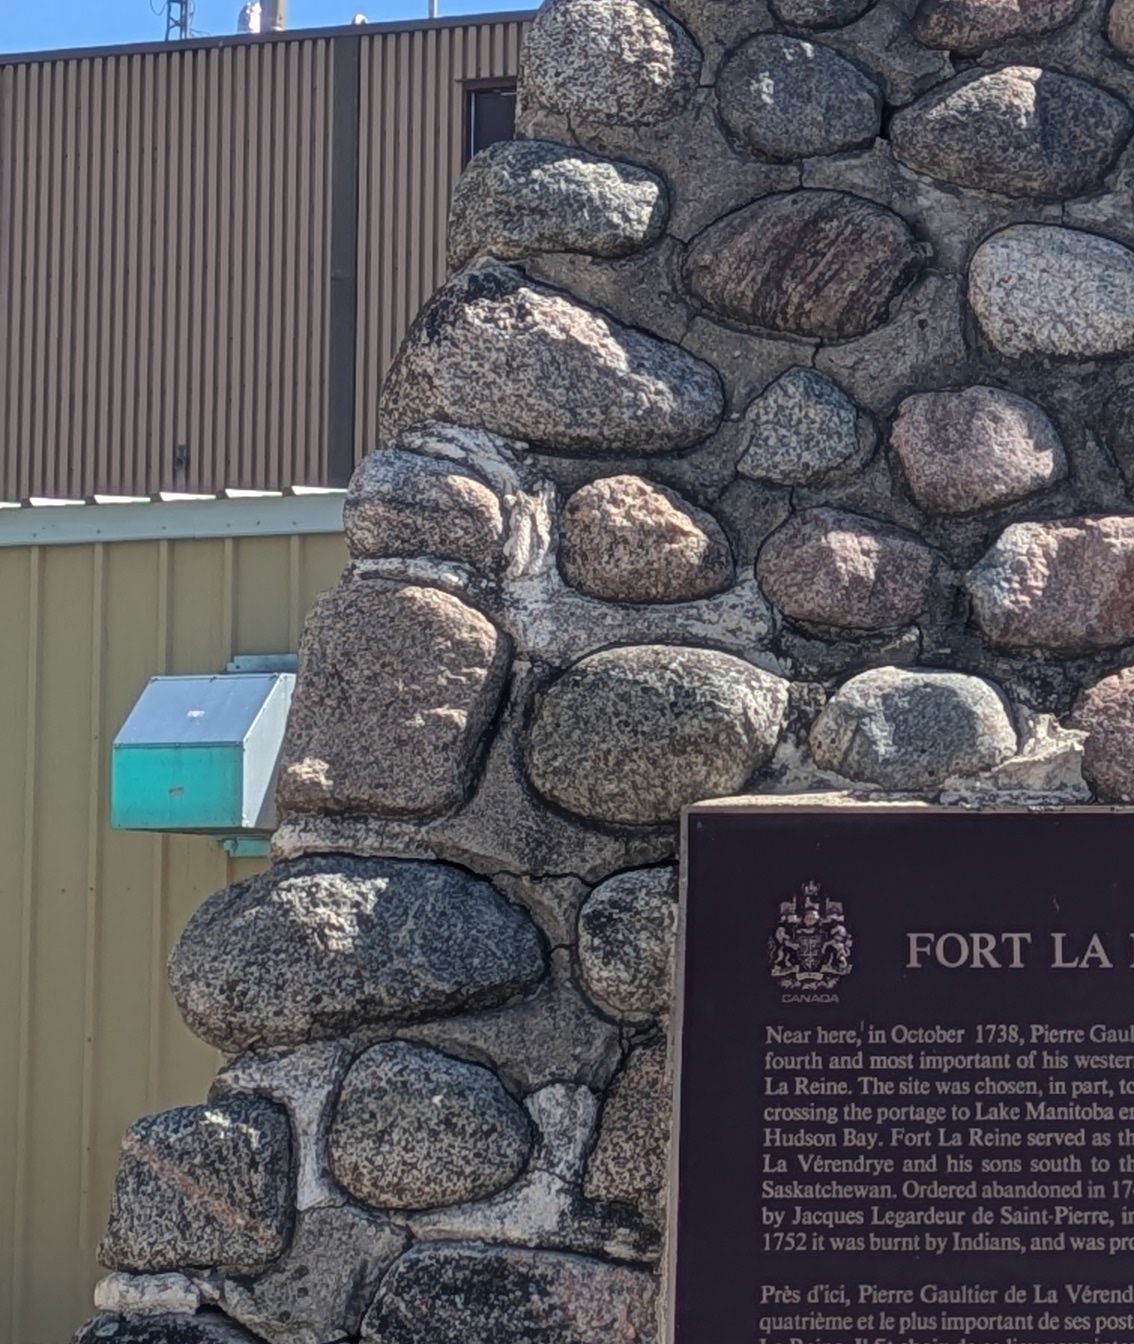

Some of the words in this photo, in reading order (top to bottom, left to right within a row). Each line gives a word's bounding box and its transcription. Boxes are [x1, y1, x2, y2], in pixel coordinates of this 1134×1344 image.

[905, 932, 1032, 969] FORT
[1050, 932, 1114, 969] LA
[781, 993, 840, 1004] CANADA
[764, 1025, 812, 1045] Near
[816, 1025, 864, 1048] here,
[867, 1023, 888, 1044] in
[890, 1024, 966, 1044] October
[975, 1023, 1026, 1047] 1738,
[1029, 1023, 1085, 1044] Pierre
[764, 1051, 824, 1071] fourth
[828, 1050, 864, 1070] and
[868, 1052, 915, 1070] most
[918, 1049, 1012, 1074] important
[1015, 1049, 1038, 1070] of
[1041, 1049, 1069, 1070] his
[762, 1127, 838, 1148] Hudson
[842, 1127, 884, 1151] Bay.
[889, 1127, 933, 1147] Fort
[937, 1127, 963, 1147] La
[967, 1127, 1023, 1148] Reine
[1026, 1127, 1087, 1147] served
[1091, 1132, 1112, 1147] as
[761, 1179, 898, 1199] Saskatchewan.
[901, 1179, 978, 1200] Ordered
[981, 1179, 1083, 1199] abandoned
[1087, 1179, 1107, 1199] in
[761, 1205, 786, 1229] by
[791, 1205, 865, 1229] Jacques
[870, 1205, 967, 1229] Legardeur
[971, 1205, 995, 1225] de
[999, 1205, 1115, 1229] Saint-Pierre,
[763, 1231, 808, 1252] 1752
[811, 1231, 826, 1251] it
[828, 1236, 866, 1251] was
[868, 1232, 921, 1252] burnt
[924, 1232, 949, 1255] by
[951, 1231, 1027, 1255] Indians,
[1029, 1231, 1066, 1252] and
[1069, 1236, 1106, 1251] was
[759, 1284, 802, 1305] Près
[806, 1283, 851, 1308] d'ici,
[857, 1283, 914, 1304] Pierre
[919, 1283, 999, 1305] Gaultier
[1004, 1284, 1027, 1304] de
[1032, 1283, 1059, 1304] La
